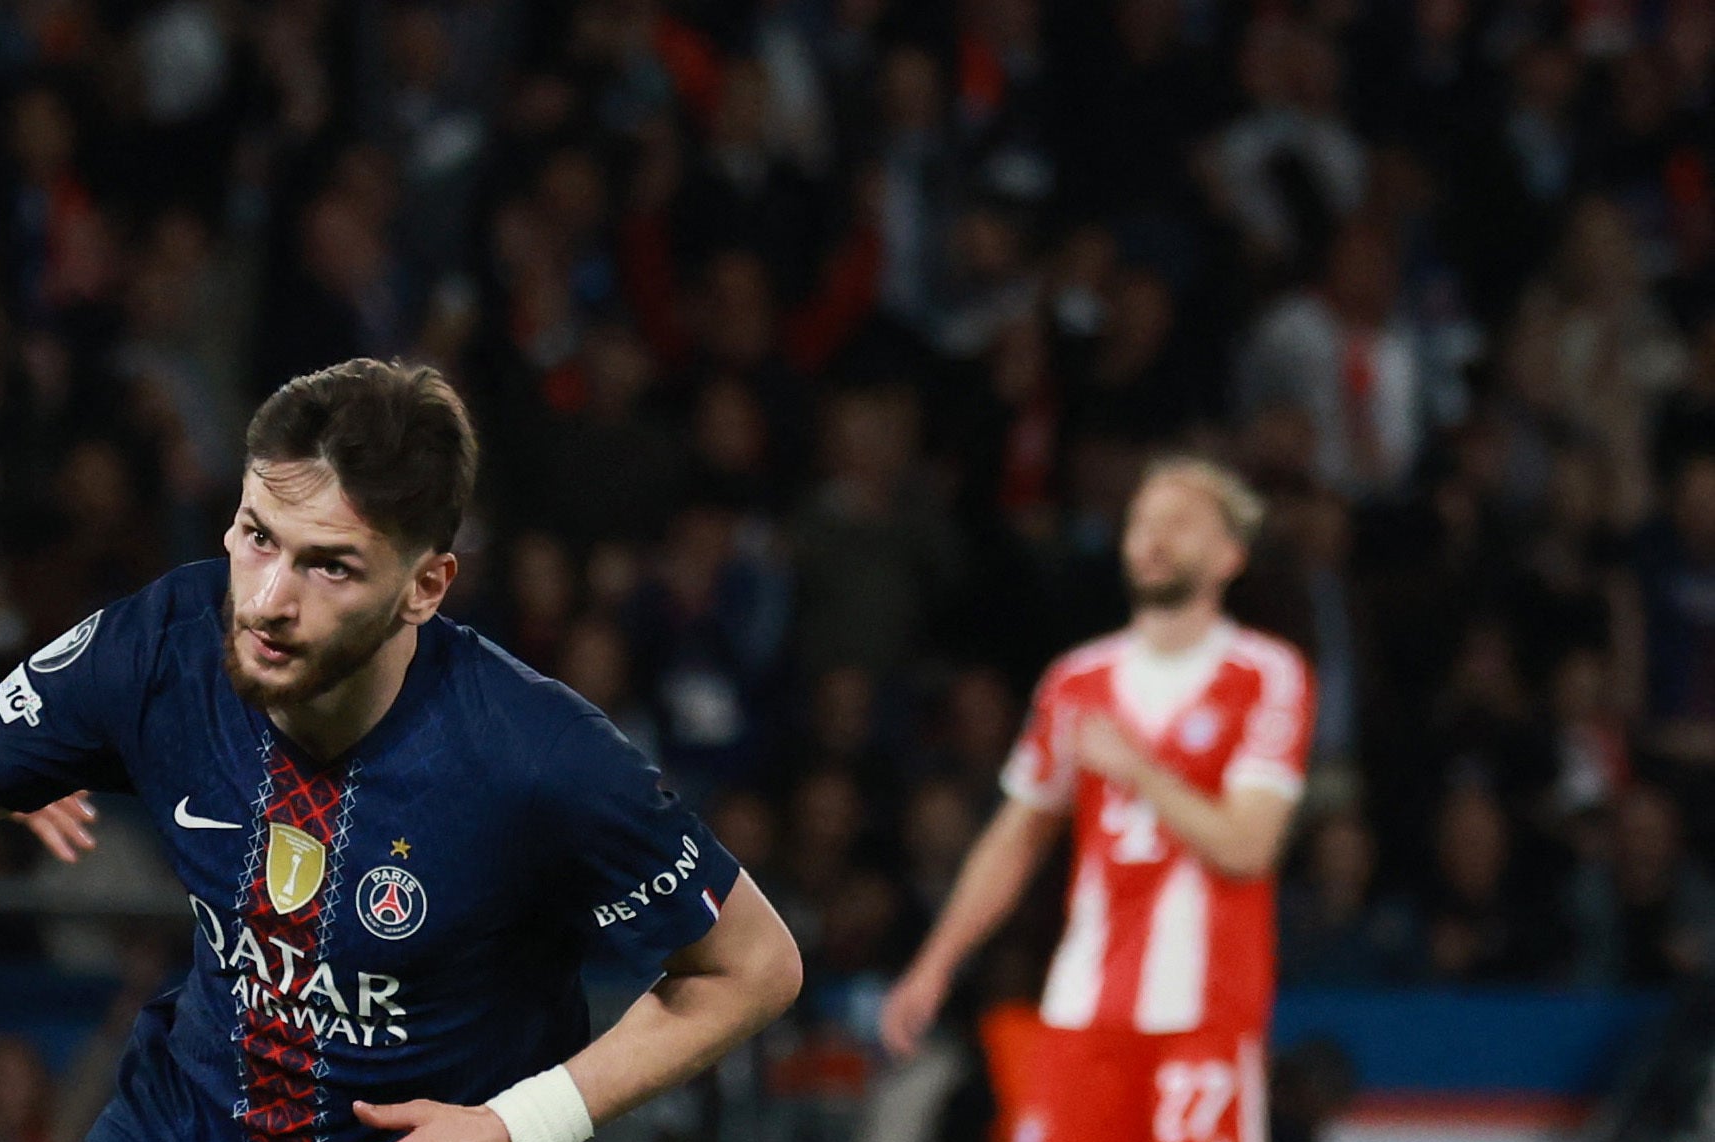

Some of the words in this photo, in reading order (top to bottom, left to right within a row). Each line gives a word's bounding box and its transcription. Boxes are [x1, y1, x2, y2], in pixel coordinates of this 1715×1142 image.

[370, 870, 416, 892] PARIS
[592, 834, 699, 927] BEYOND
[188, 893, 407, 1018] QATAR
